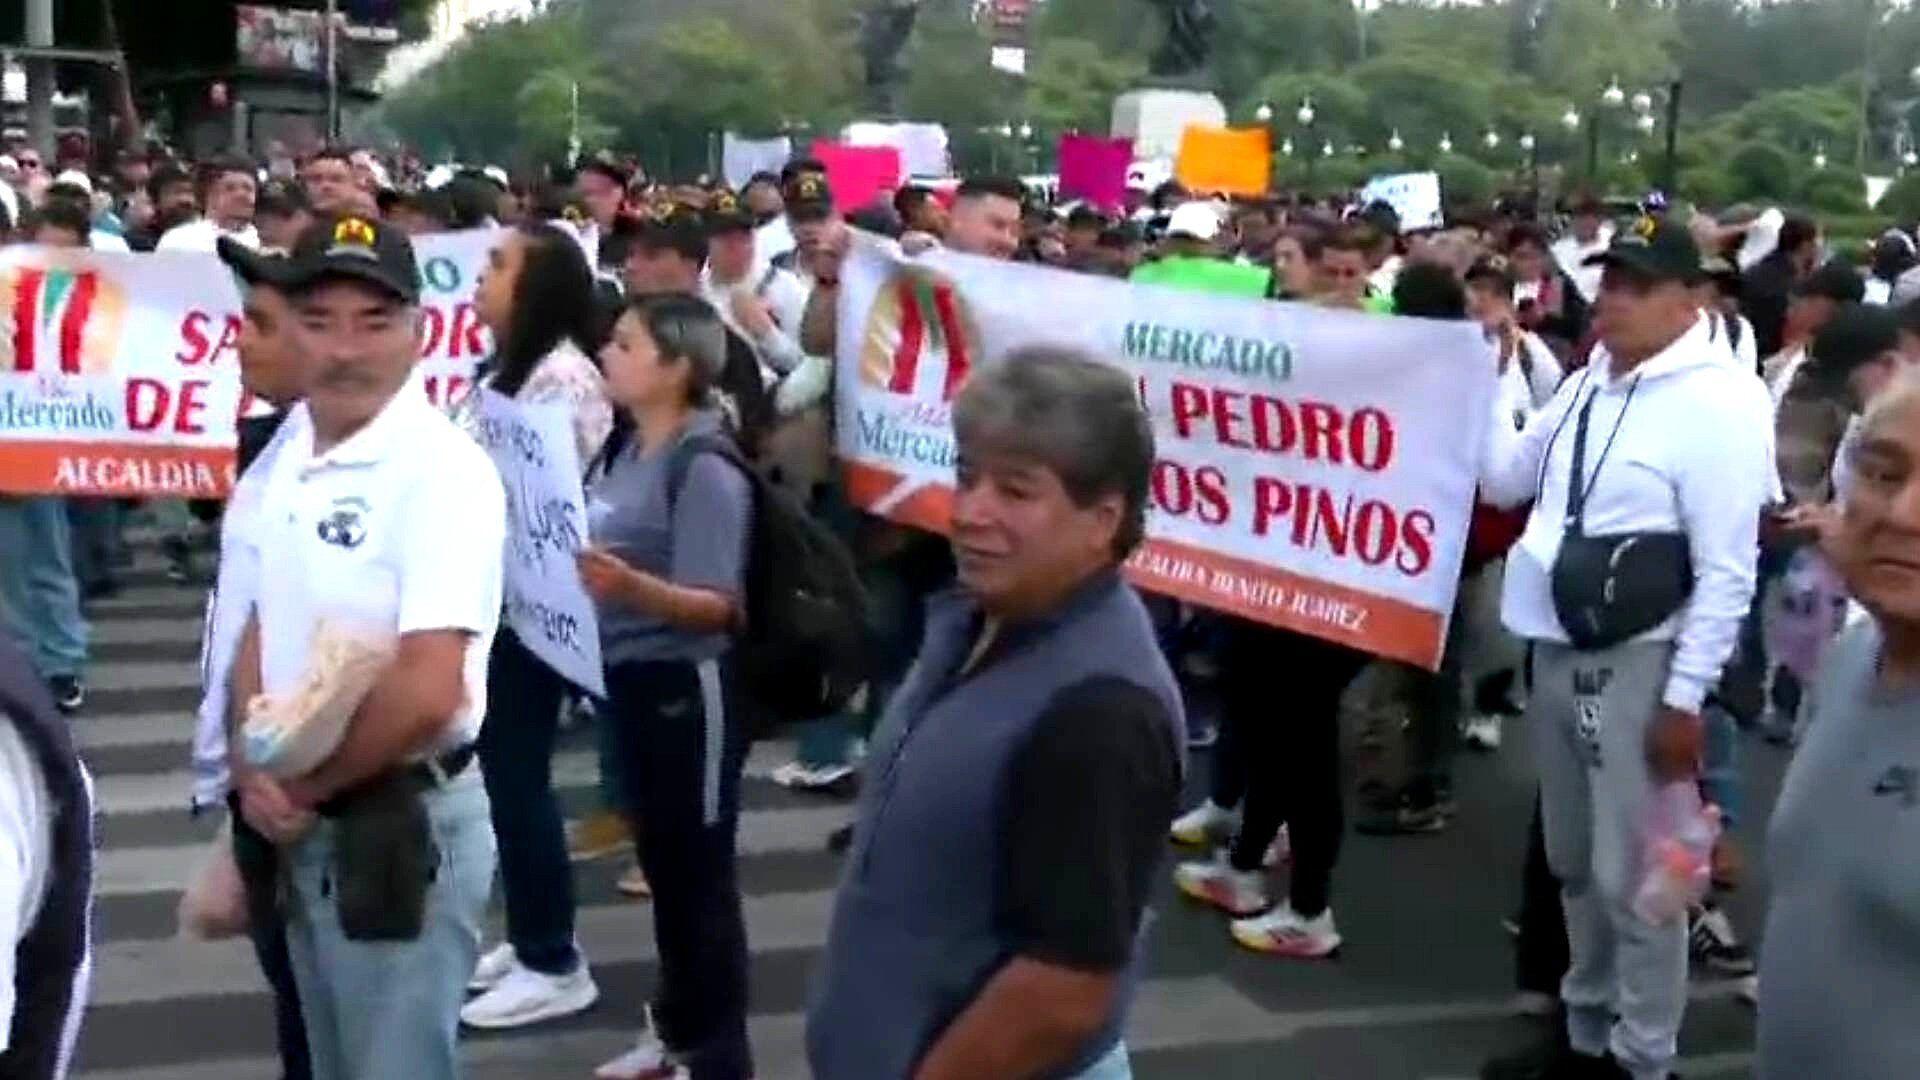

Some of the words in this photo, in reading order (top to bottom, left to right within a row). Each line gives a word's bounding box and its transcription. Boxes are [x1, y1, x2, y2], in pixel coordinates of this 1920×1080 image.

[175, 310, 242, 366] SA
[1121, 321, 1294, 381] MERCADO
[125, 378, 212, 434] DE
[1171, 381, 1394, 472] PEDRO
[856, 407, 954, 467] Merca
[52, 456, 217, 490] ALCALDIA
[1147, 460, 1231, 525] OS
[1251, 475, 1437, 577] PINOS
[1289, 591, 1373, 631] JUAREZ
